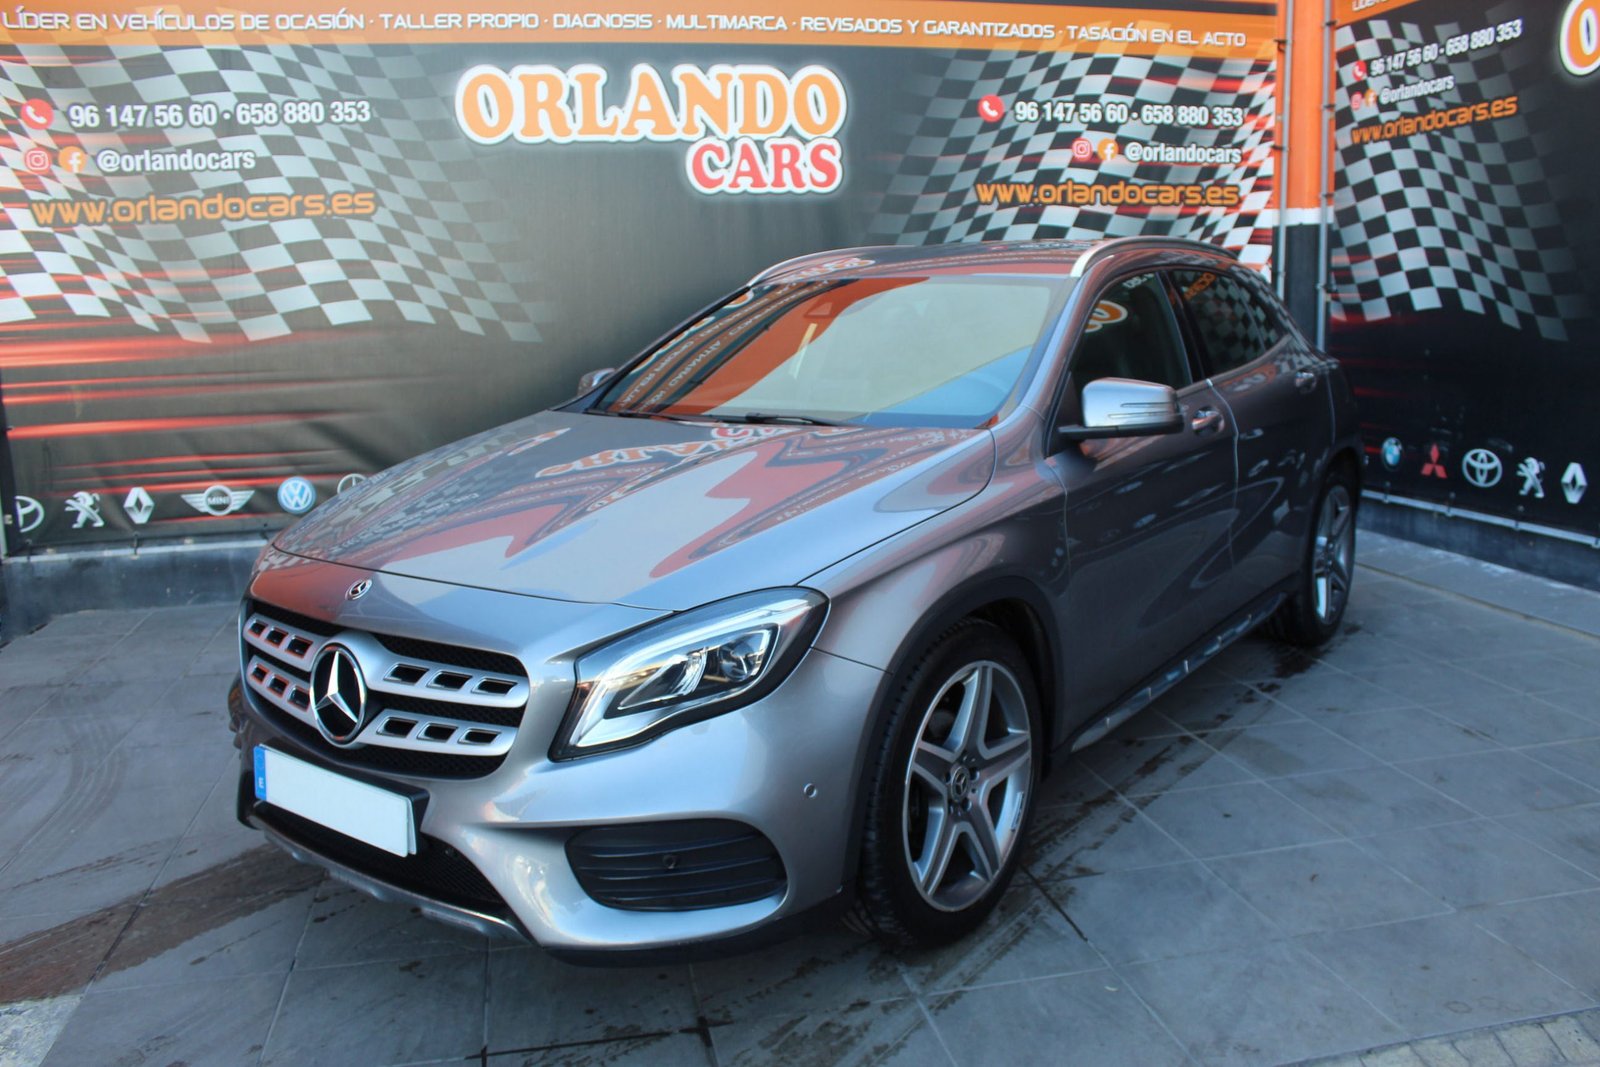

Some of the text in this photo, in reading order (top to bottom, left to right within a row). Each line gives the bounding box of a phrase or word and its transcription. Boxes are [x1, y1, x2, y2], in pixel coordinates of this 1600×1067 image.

[2, 6, 1246, 47] LÍDER EN VEHÍCULOS DE OCASIÓN TALLER PROPIO DIAGNOSIS MULTIMARCA REVISADOS Y GARANTIZADOS TASACIÓN EN EL ACTO
[1370, 18, 1522, 76] 96 147 56 60 658 880 353
[456, 64, 846, 142] ORLANDO
[1380, 75, 1455, 104] @orlandocars
[69, 100, 371, 128] 96 147 56 60 658 880 353
[1015, 101, 1243, 127] 96 147 56 60 658 880 353
[1351, 96, 1518, 144] www.orlandocars.es
[97, 148, 256, 172] @orlandocars
[687, 138, 842, 192] CARS
[1124, 142, 1241, 164] @orlandocars
[31, 191, 376, 225] www.orlandocars.es
[975, 180, 1240, 206] www.orlandocars.es
